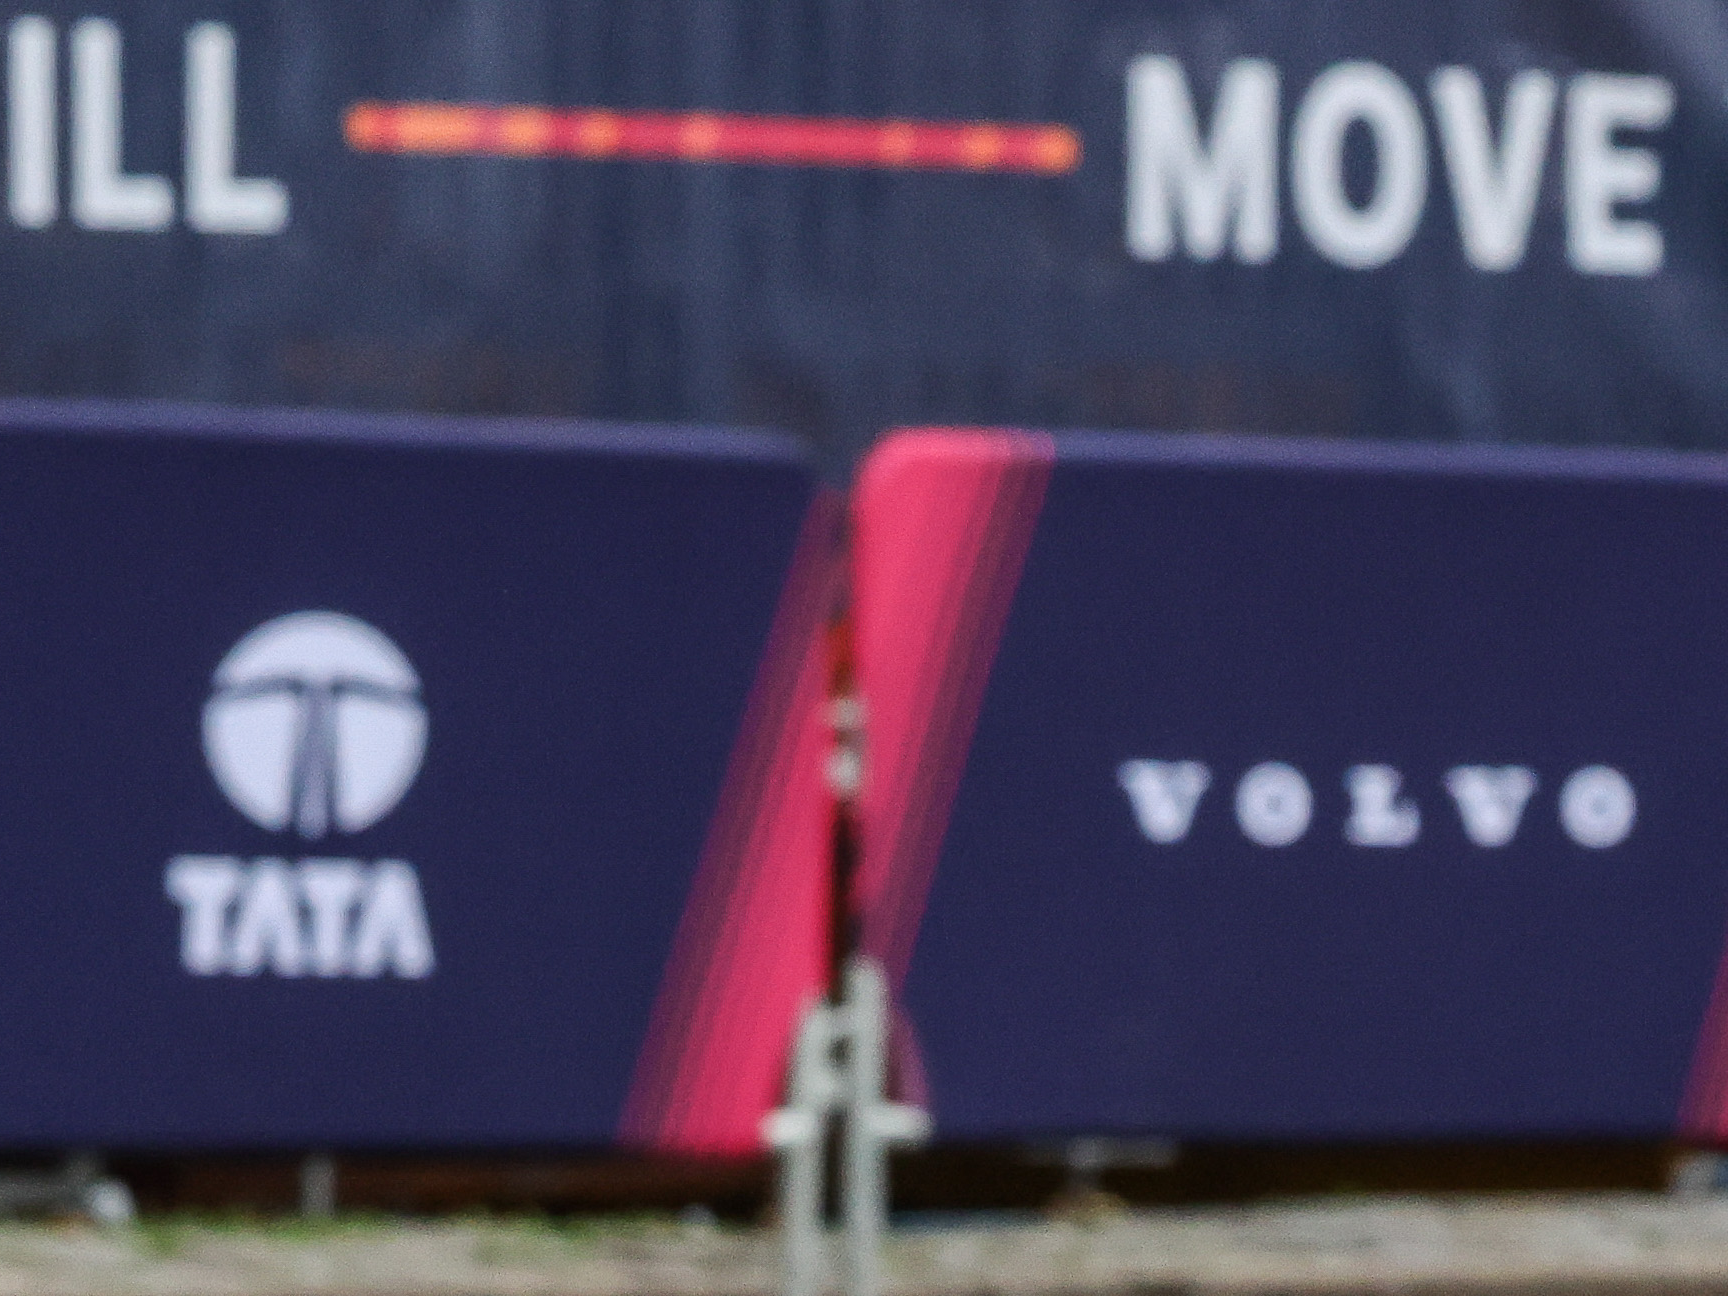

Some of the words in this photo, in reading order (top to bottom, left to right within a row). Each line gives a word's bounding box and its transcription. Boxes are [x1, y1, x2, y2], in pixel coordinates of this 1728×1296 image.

[1125, 53, 1675, 276] MOVE
[1115, 758, 1638, 849] VOLVO
[163, 853, 436, 979] TATA
